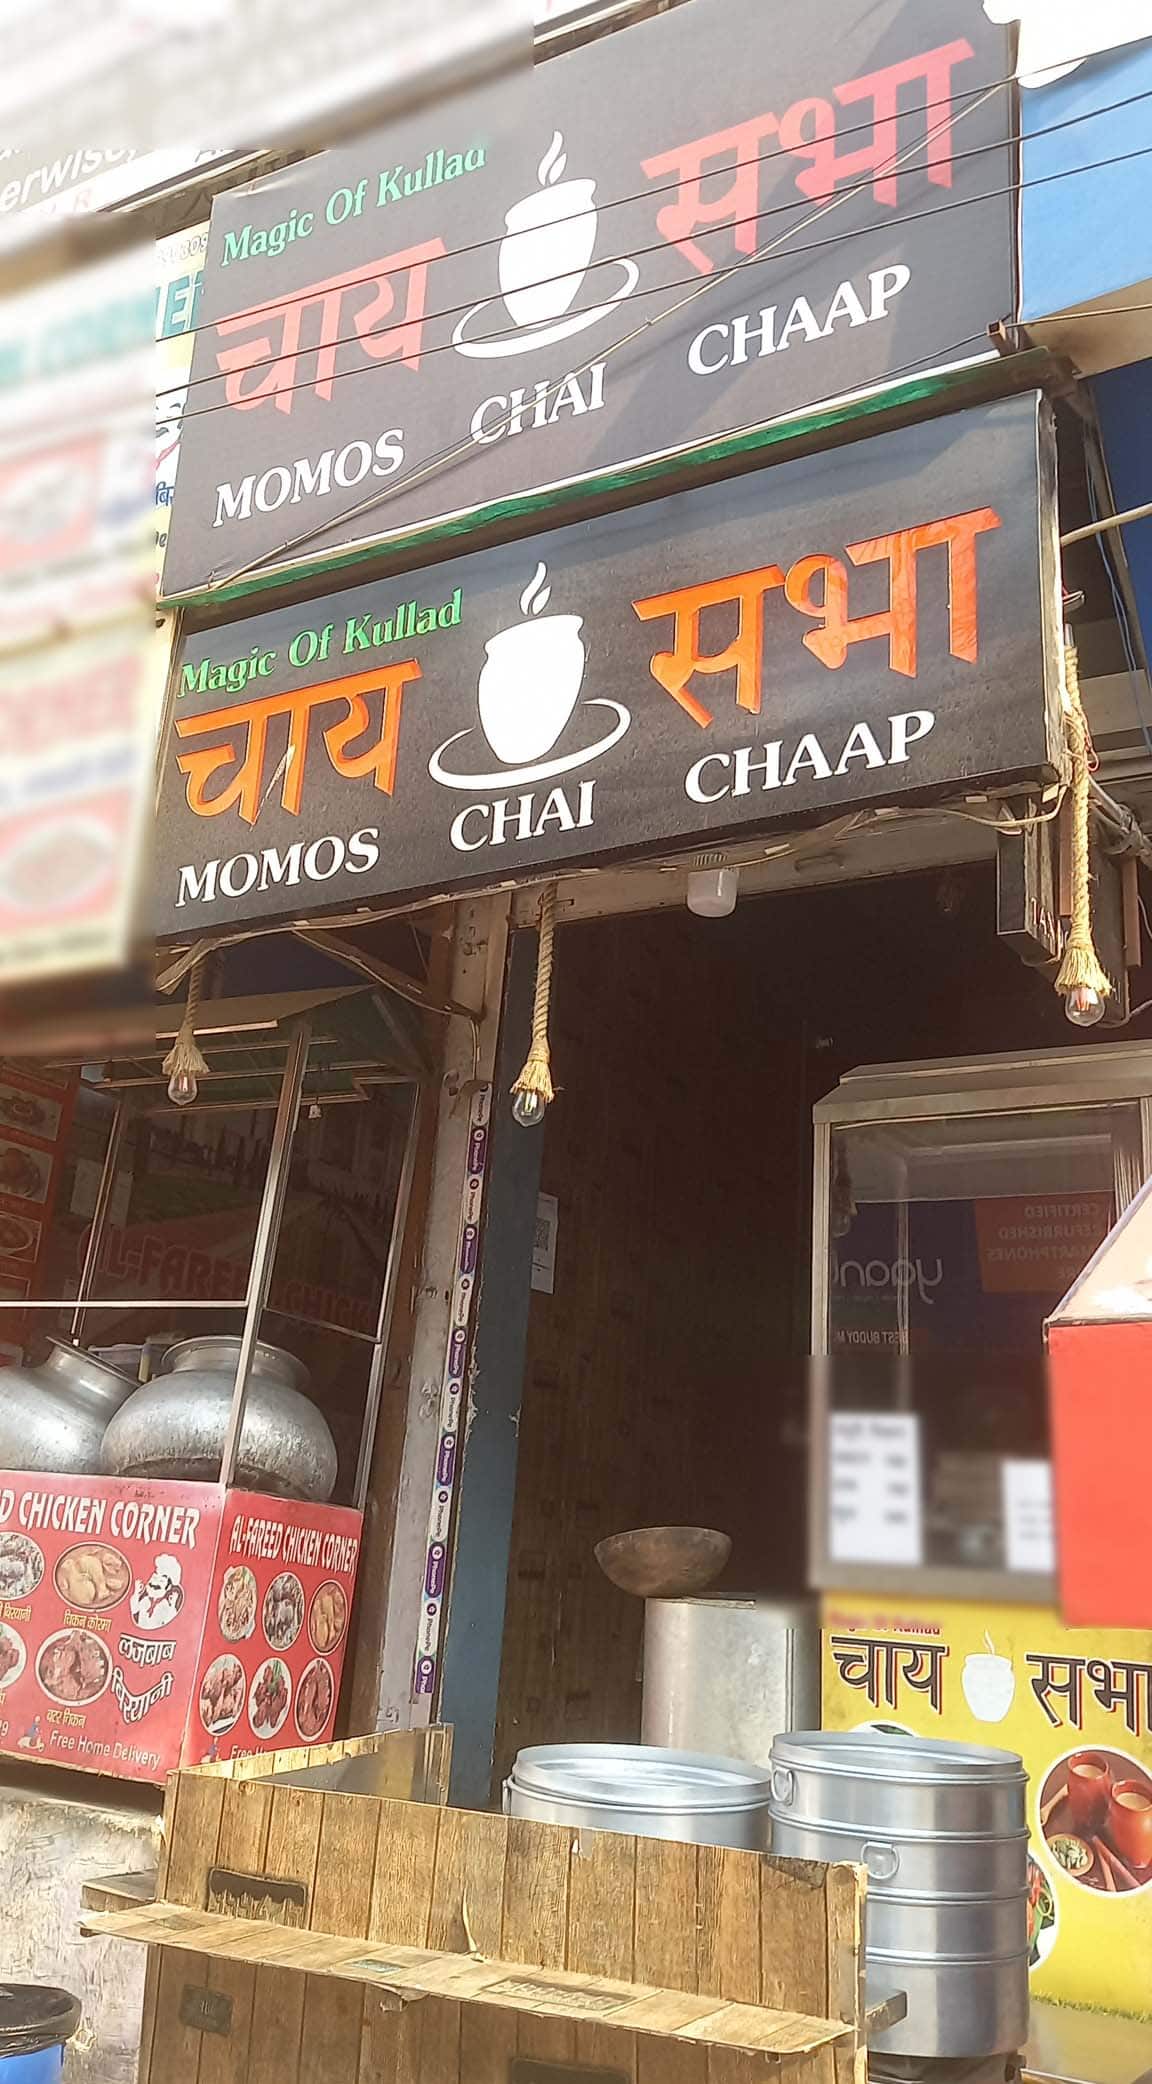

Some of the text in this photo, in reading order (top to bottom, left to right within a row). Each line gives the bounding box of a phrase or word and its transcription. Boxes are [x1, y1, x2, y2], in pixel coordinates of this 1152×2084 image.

[216, 237, 447, 415] चाय
[640, 37, 976, 275] सभा
[220, 209, 315, 266] Magic
[325, 178, 369, 226] Of
[212, 263, 912, 528] MOMOS CHAI CHAAP
[174, 506, 1002, 826] चाय सभा
[176, 587, 463, 699] Magic Of Kullad
[175, 709, 935, 907] MOMOS CHAI CHAAP
[19, 1492, 107, 1534] CHICKEN
[110, 1500, 200, 1549] CORNER
[229, 1514, 359, 1576] AL-FAREED CHICKEN CORNER
[424, 1618, 434, 1652] PhonePe
[831, 1636, 950, 1715] चाय
[50, 1730, 161, 1771] Free Home Delivery
